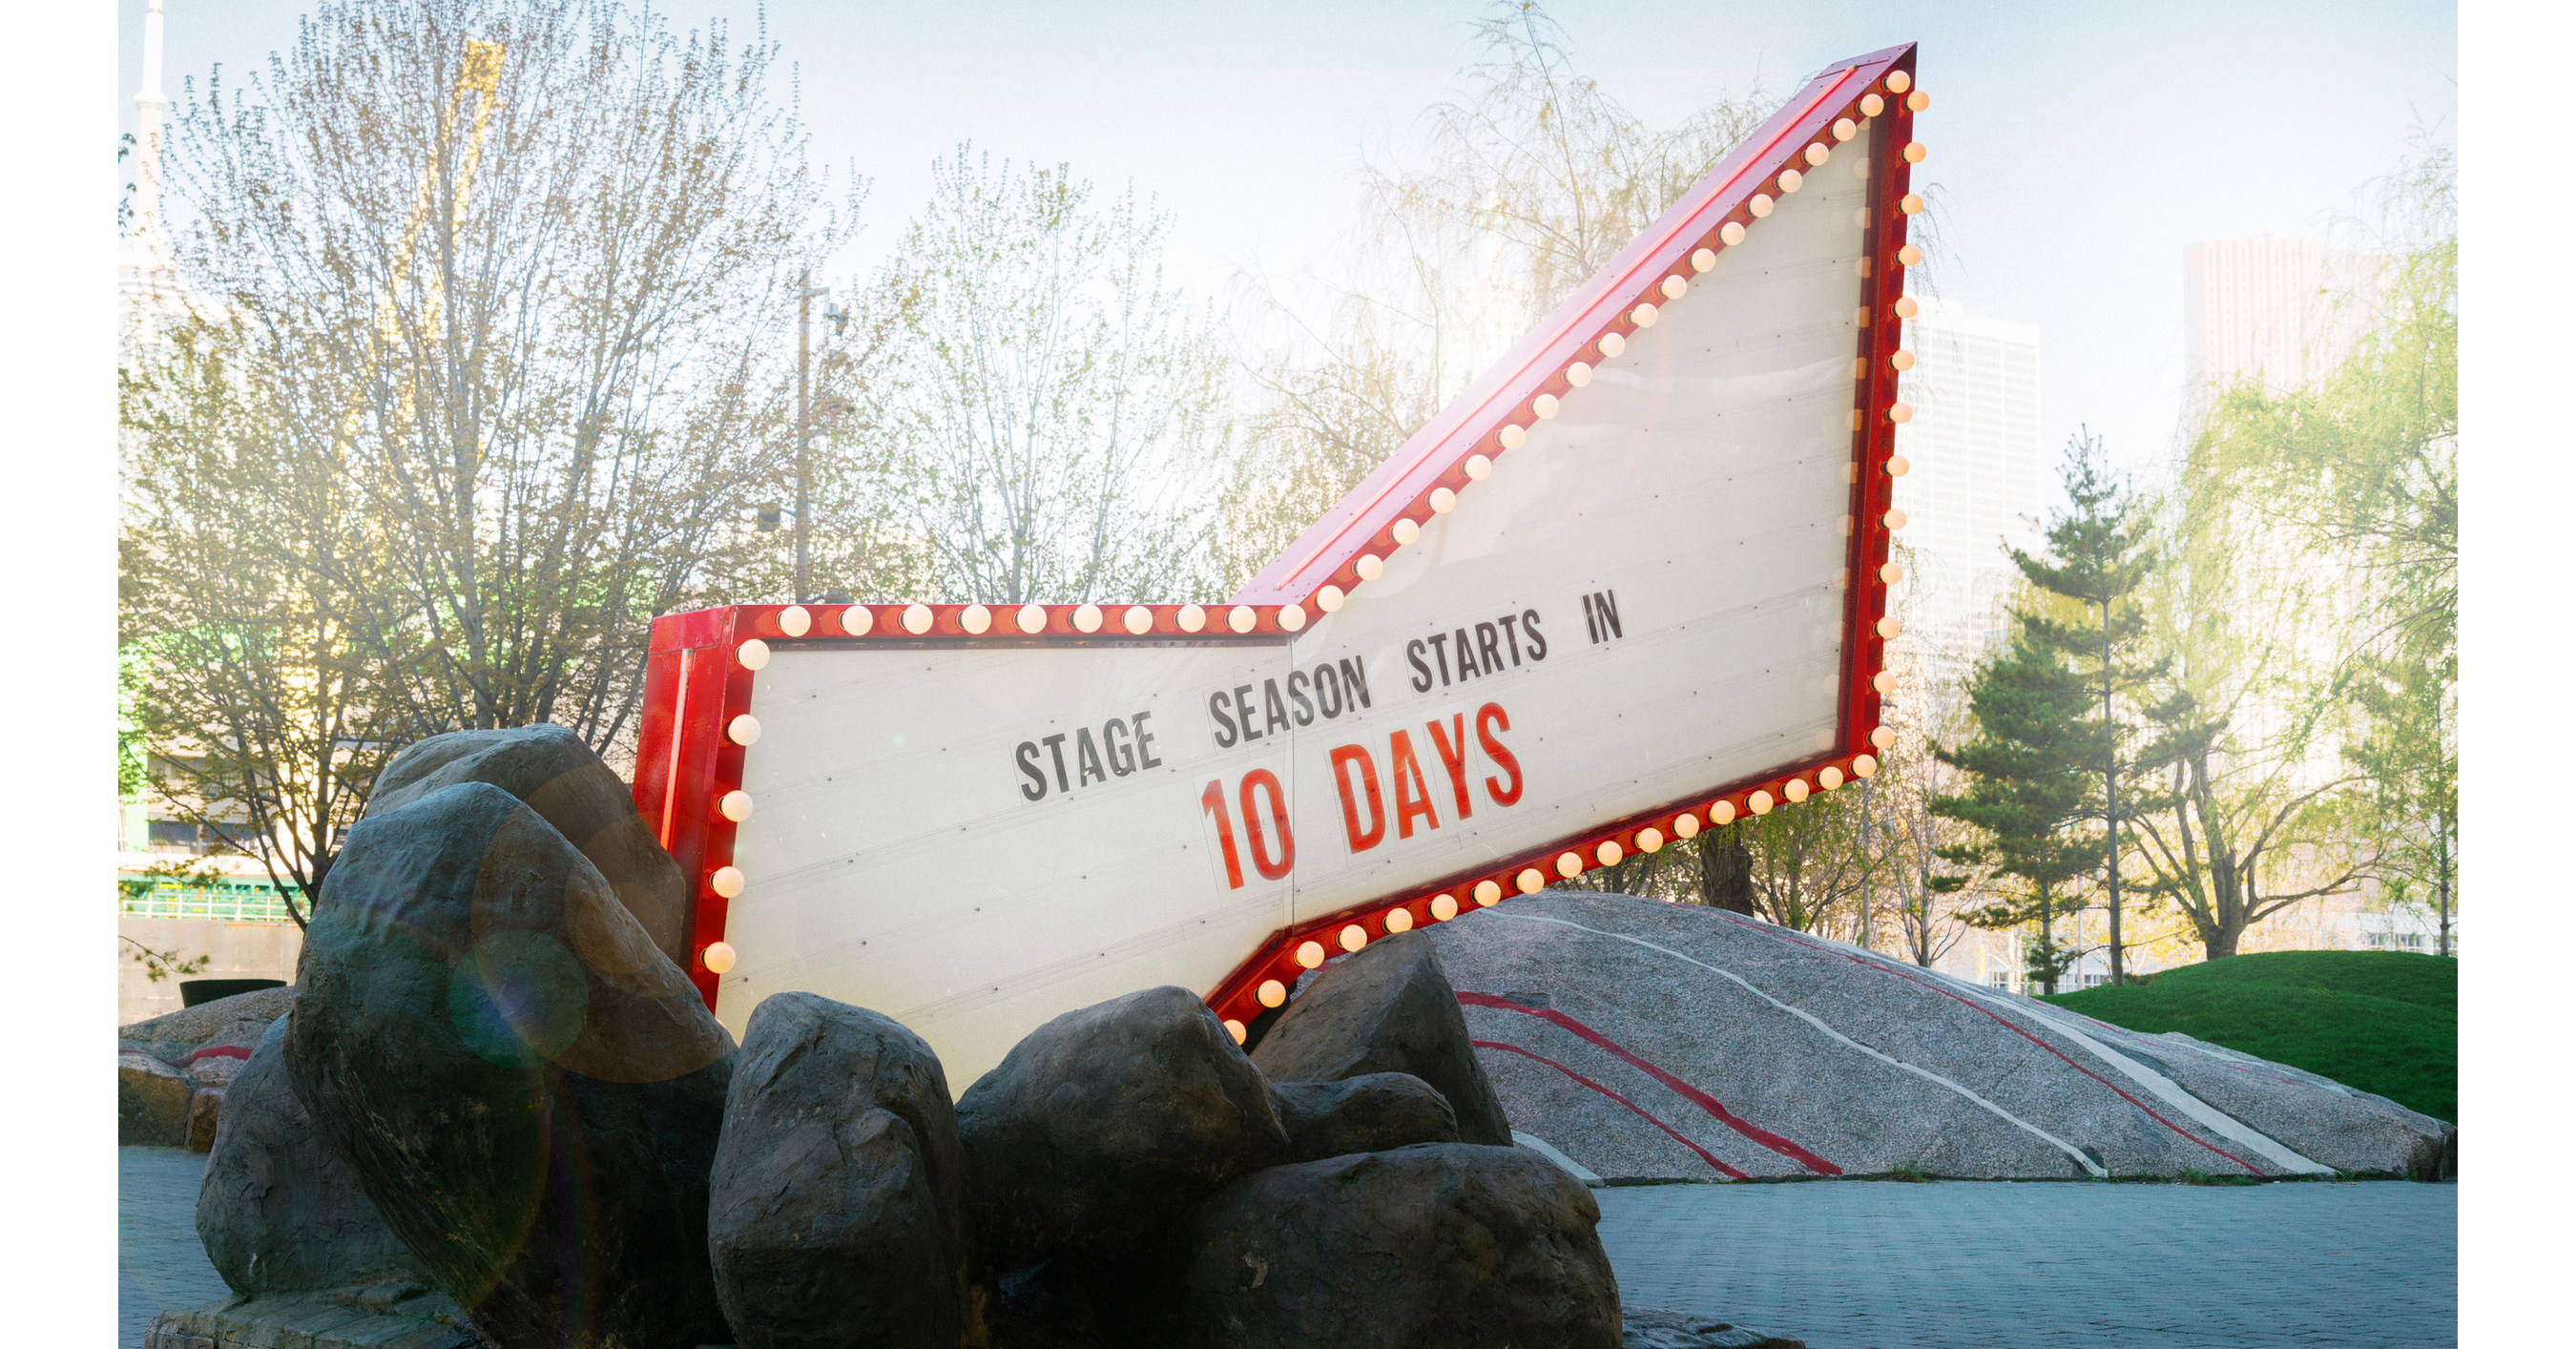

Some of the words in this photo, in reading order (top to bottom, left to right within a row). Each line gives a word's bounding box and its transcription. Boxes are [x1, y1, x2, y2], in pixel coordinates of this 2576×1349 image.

[1015, 712, 1162, 801] STAGE
[1209, 655, 1371, 748] SEASON
[1407, 609, 1548, 693] STARTS
[1582, 590, 1623, 645] IN
[1201, 769, 1296, 890] 10
[1330, 703, 1524, 854] DAYS
